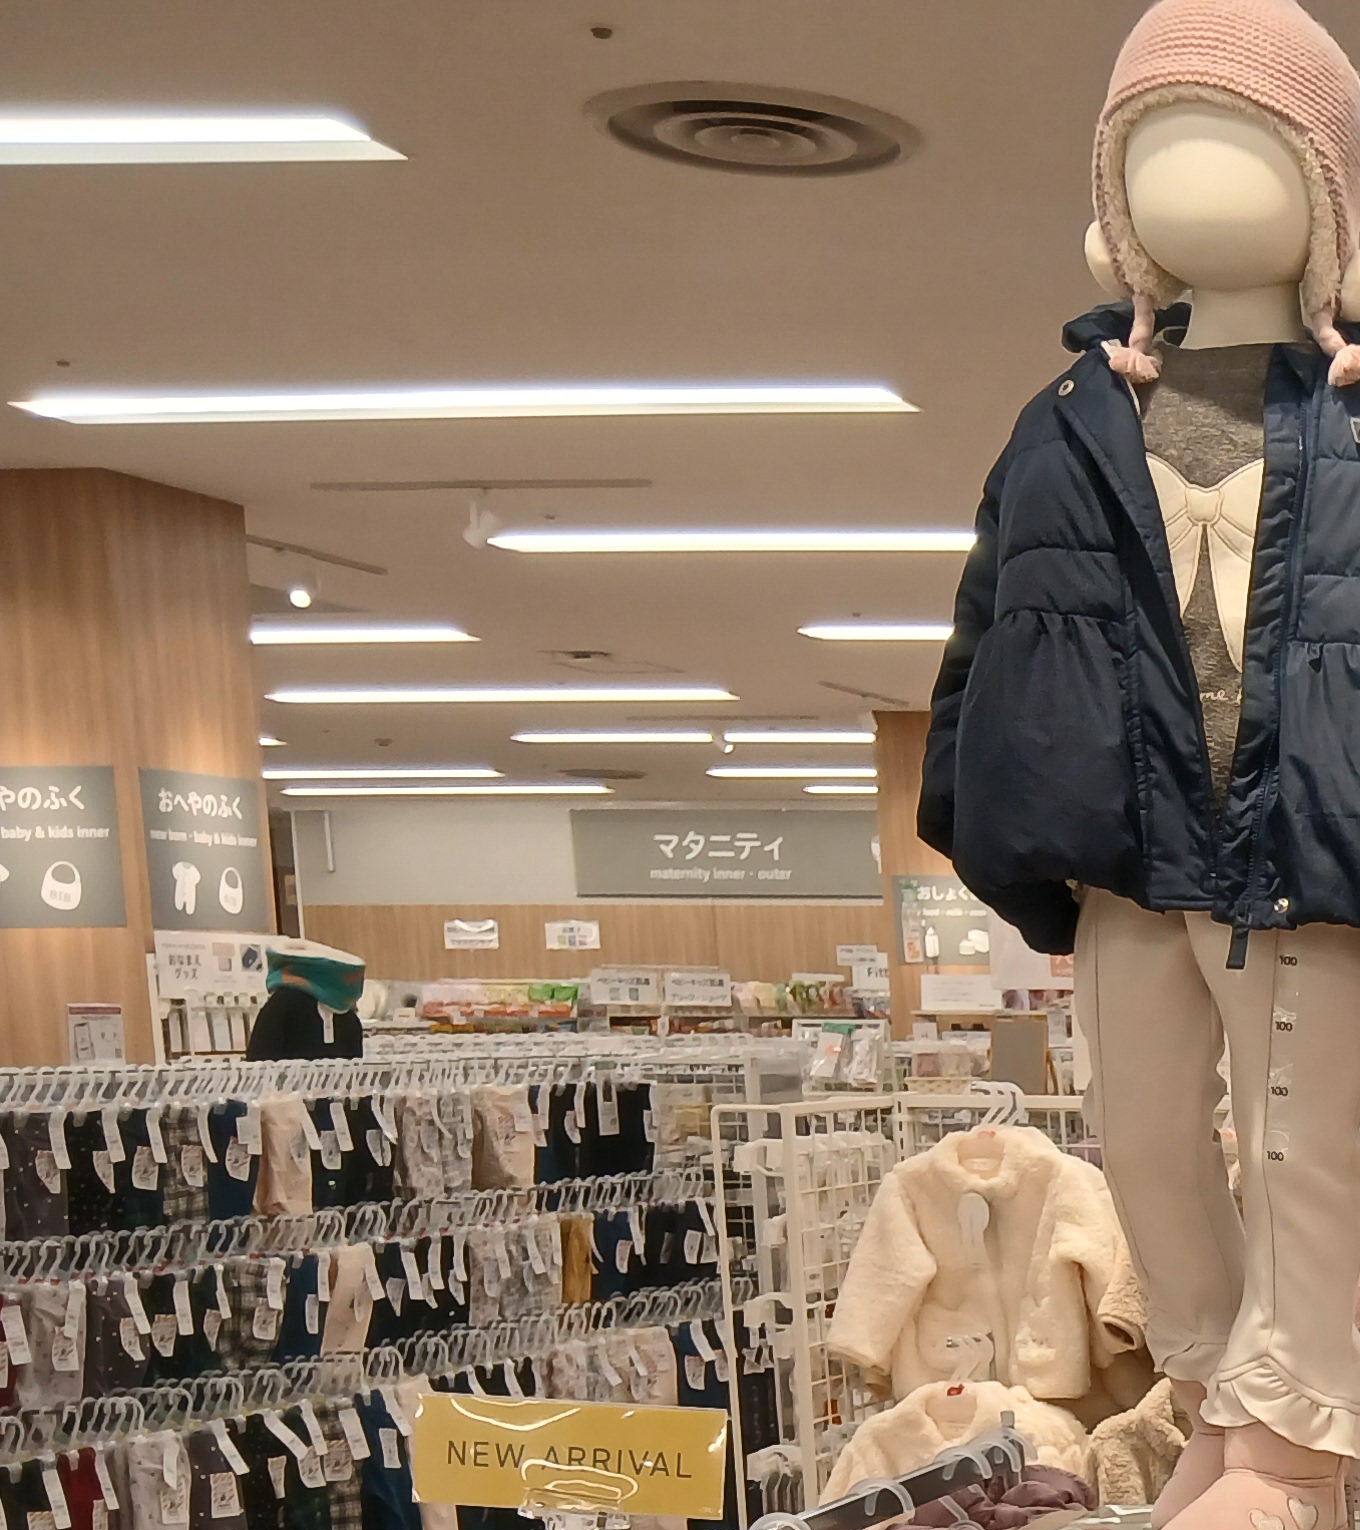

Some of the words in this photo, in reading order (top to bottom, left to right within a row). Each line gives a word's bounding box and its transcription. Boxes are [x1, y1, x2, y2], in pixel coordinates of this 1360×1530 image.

[158, 788, 243, 820] おへやのふく
[48, 826, 74, 839] kids
[77, 826, 110, 839] inner
[653, 830, 783, 860] マタニティ
[650, 867, 711, 882] maternity
[713, 867, 746, 881] inner
[757, 868, 793, 881] outer
[1280, 955, 1297, 966] 100
[1275, 1021, 1293, 1032] 100
[1271, 1086, 1288, 1097] 100
[1267, 1151, 1284, 1161] 100
[447, 1440, 524, 1469] NEW
[542, 1445, 693, 1479] ARRIVAL
